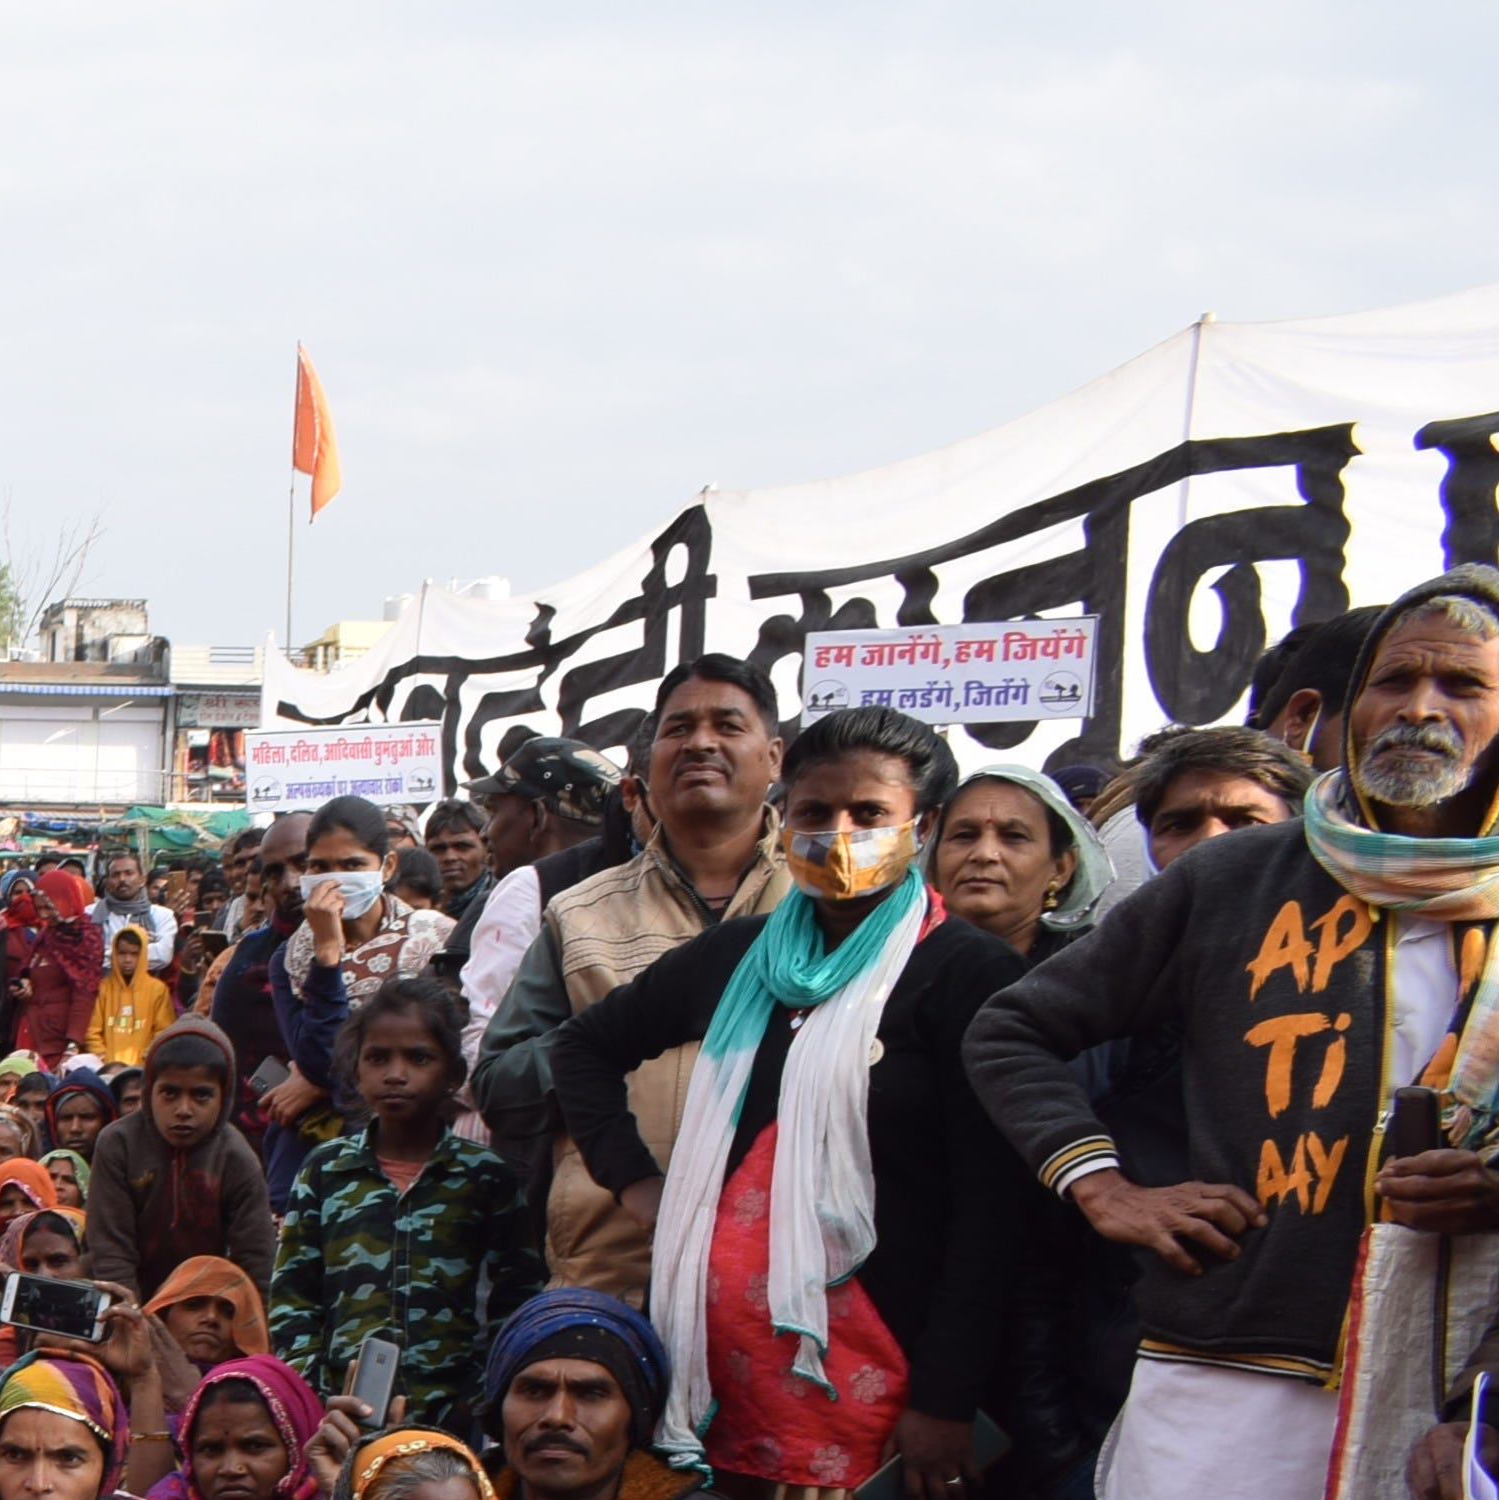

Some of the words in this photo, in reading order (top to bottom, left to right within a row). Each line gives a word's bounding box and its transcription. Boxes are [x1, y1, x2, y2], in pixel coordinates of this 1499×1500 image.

[814, 644, 856, 669] हम
[861, 634, 952, 669] जानेंगे,
[955, 639, 998, 664] हम
[1001, 628, 1087, 661] जियेंगे
[860, 688, 894, 709] हम
[963, 677, 1031, 707] जितेंगे
[415, 732, 435, 757] और
